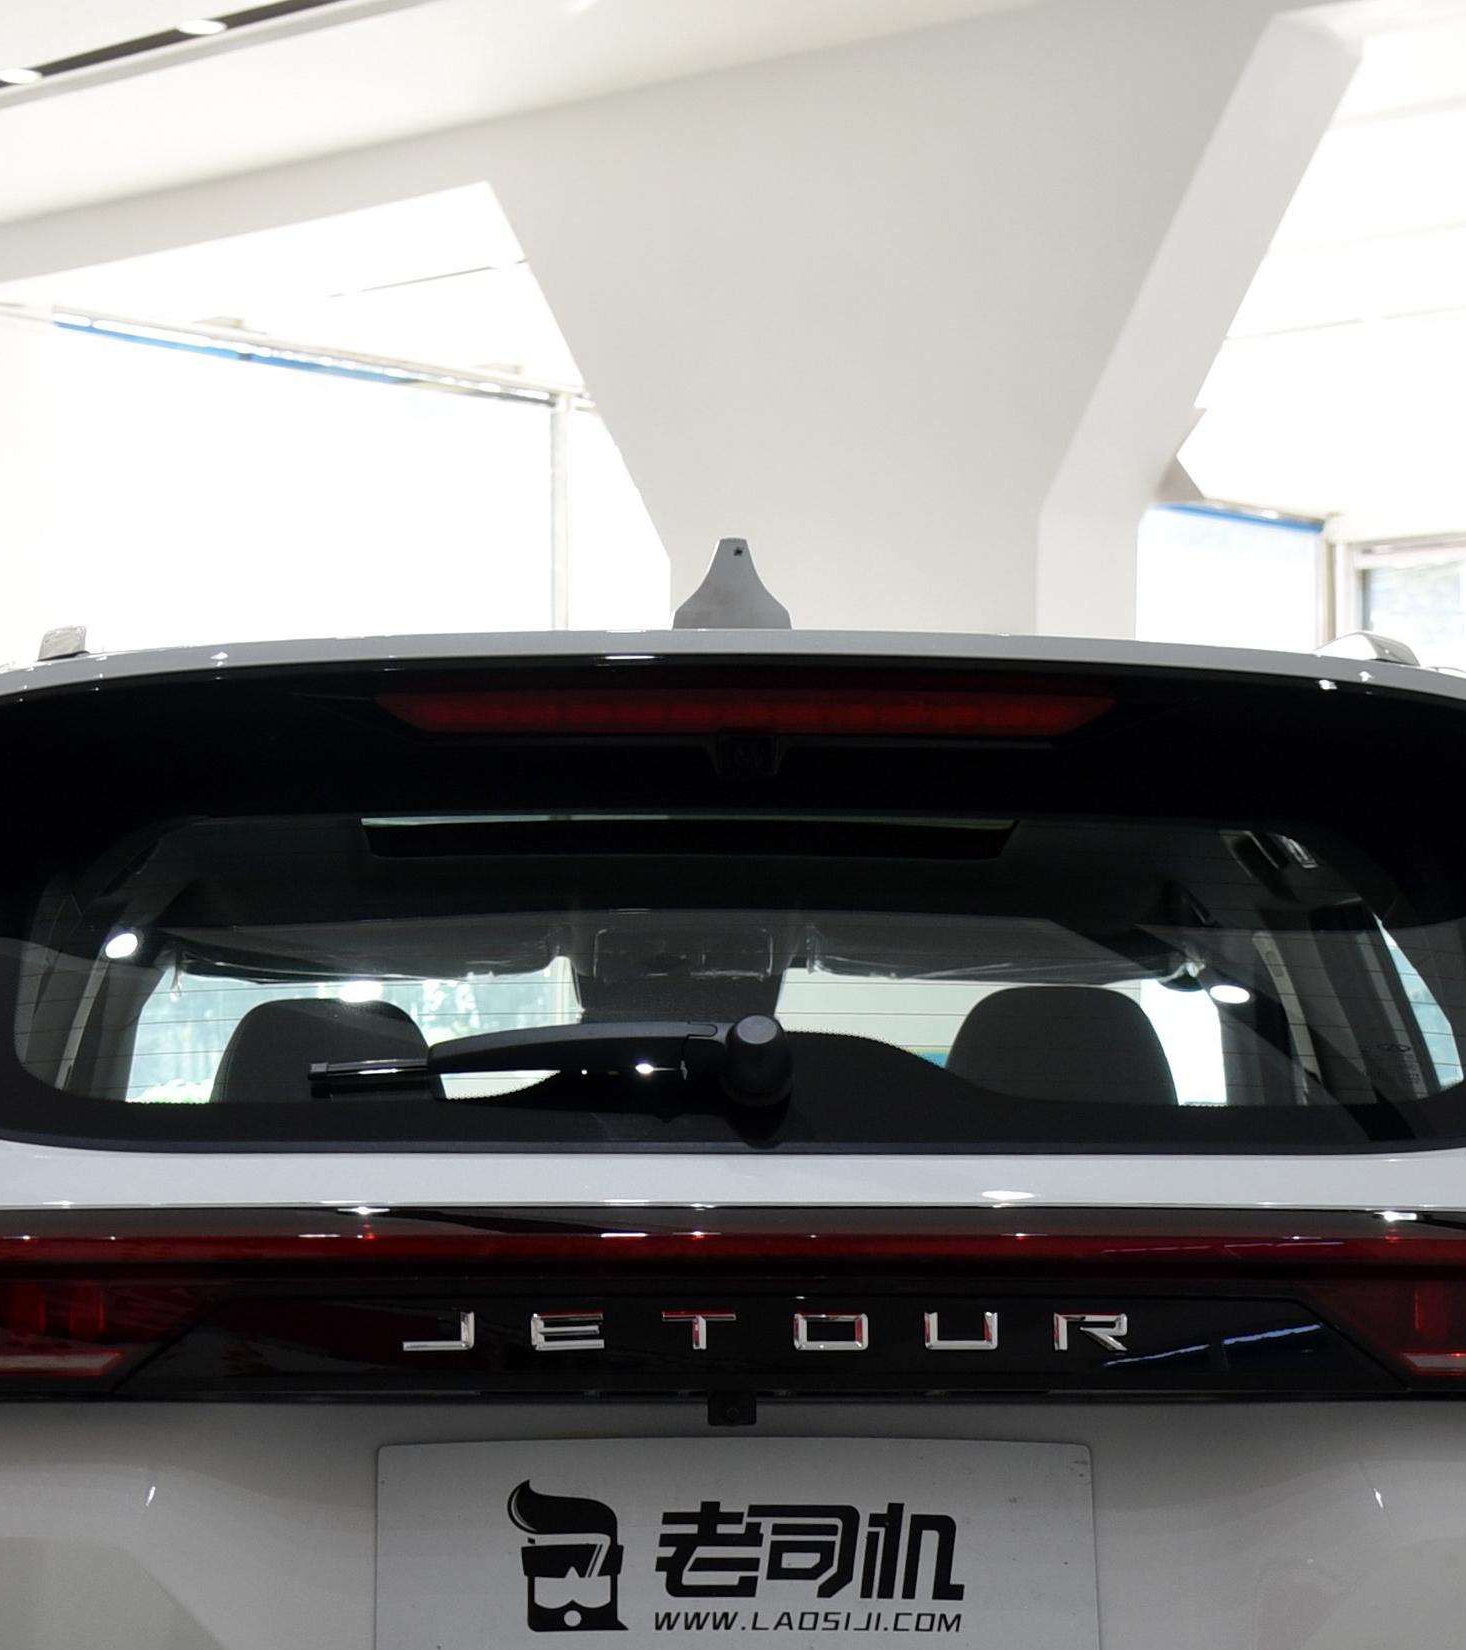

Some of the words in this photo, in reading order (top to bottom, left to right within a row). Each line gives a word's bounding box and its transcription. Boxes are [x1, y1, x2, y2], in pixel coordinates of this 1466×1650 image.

[401, 1310, 1129, 1352] JETOUR
[654, 1500, 965, 1601] 老司机
[654, 1610, 963, 1633] WWW.LAOSIJI.COM
